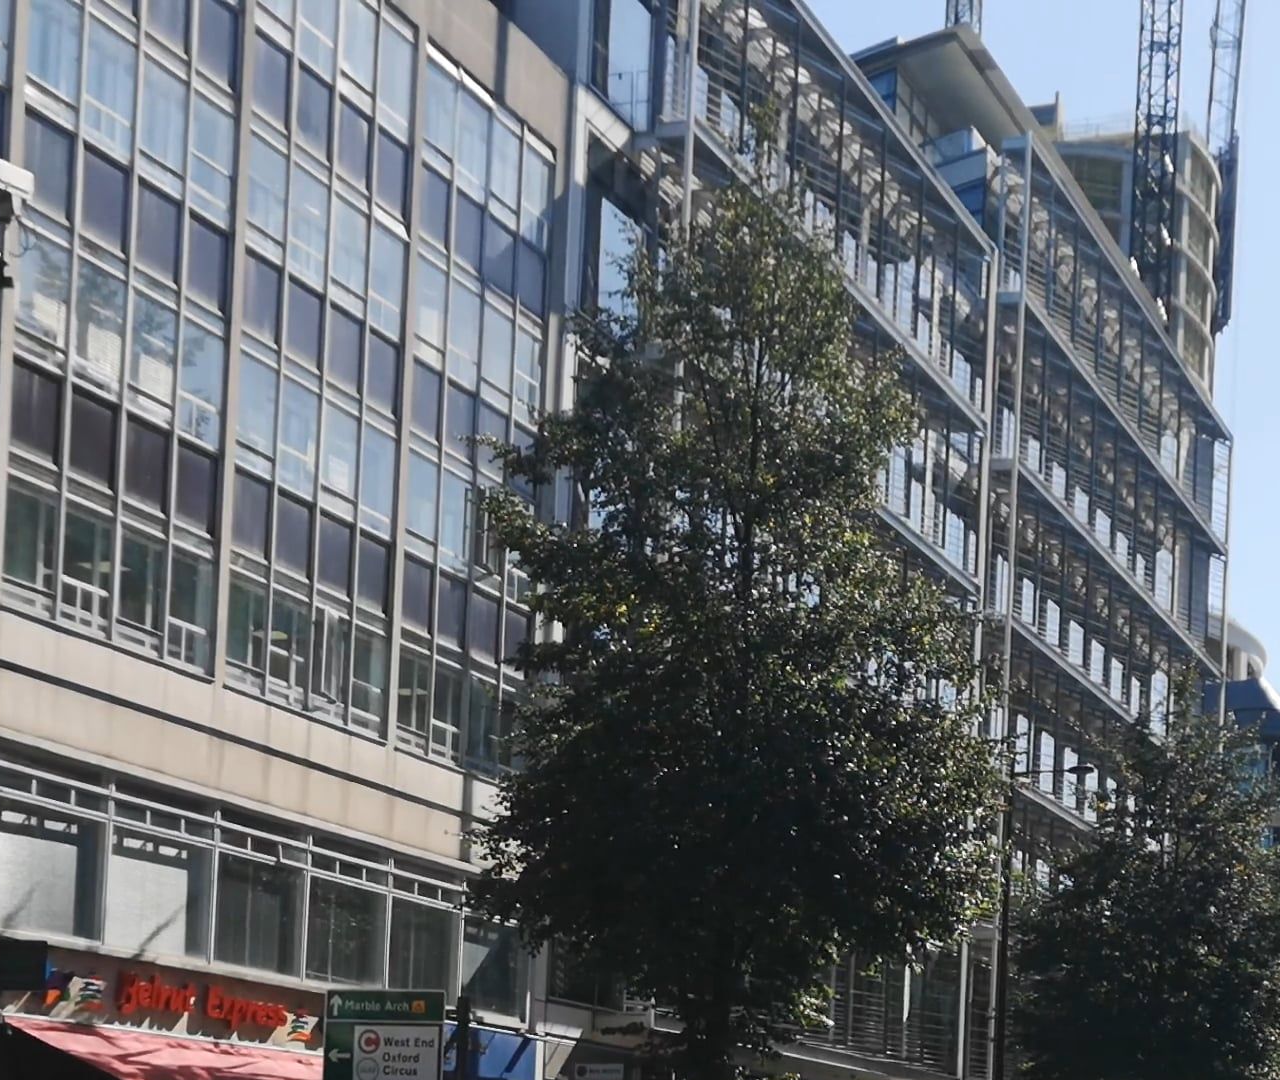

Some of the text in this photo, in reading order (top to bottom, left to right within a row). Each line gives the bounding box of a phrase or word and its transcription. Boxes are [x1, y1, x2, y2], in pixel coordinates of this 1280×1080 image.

[207, 984, 289, 1030] Express
[344, 1000, 409, 1011] Marble Arch
[383, 1038, 435, 1048] West End
[382, 1053, 420, 1063] Oxford
[382, 1065, 418, 1076] Circus
